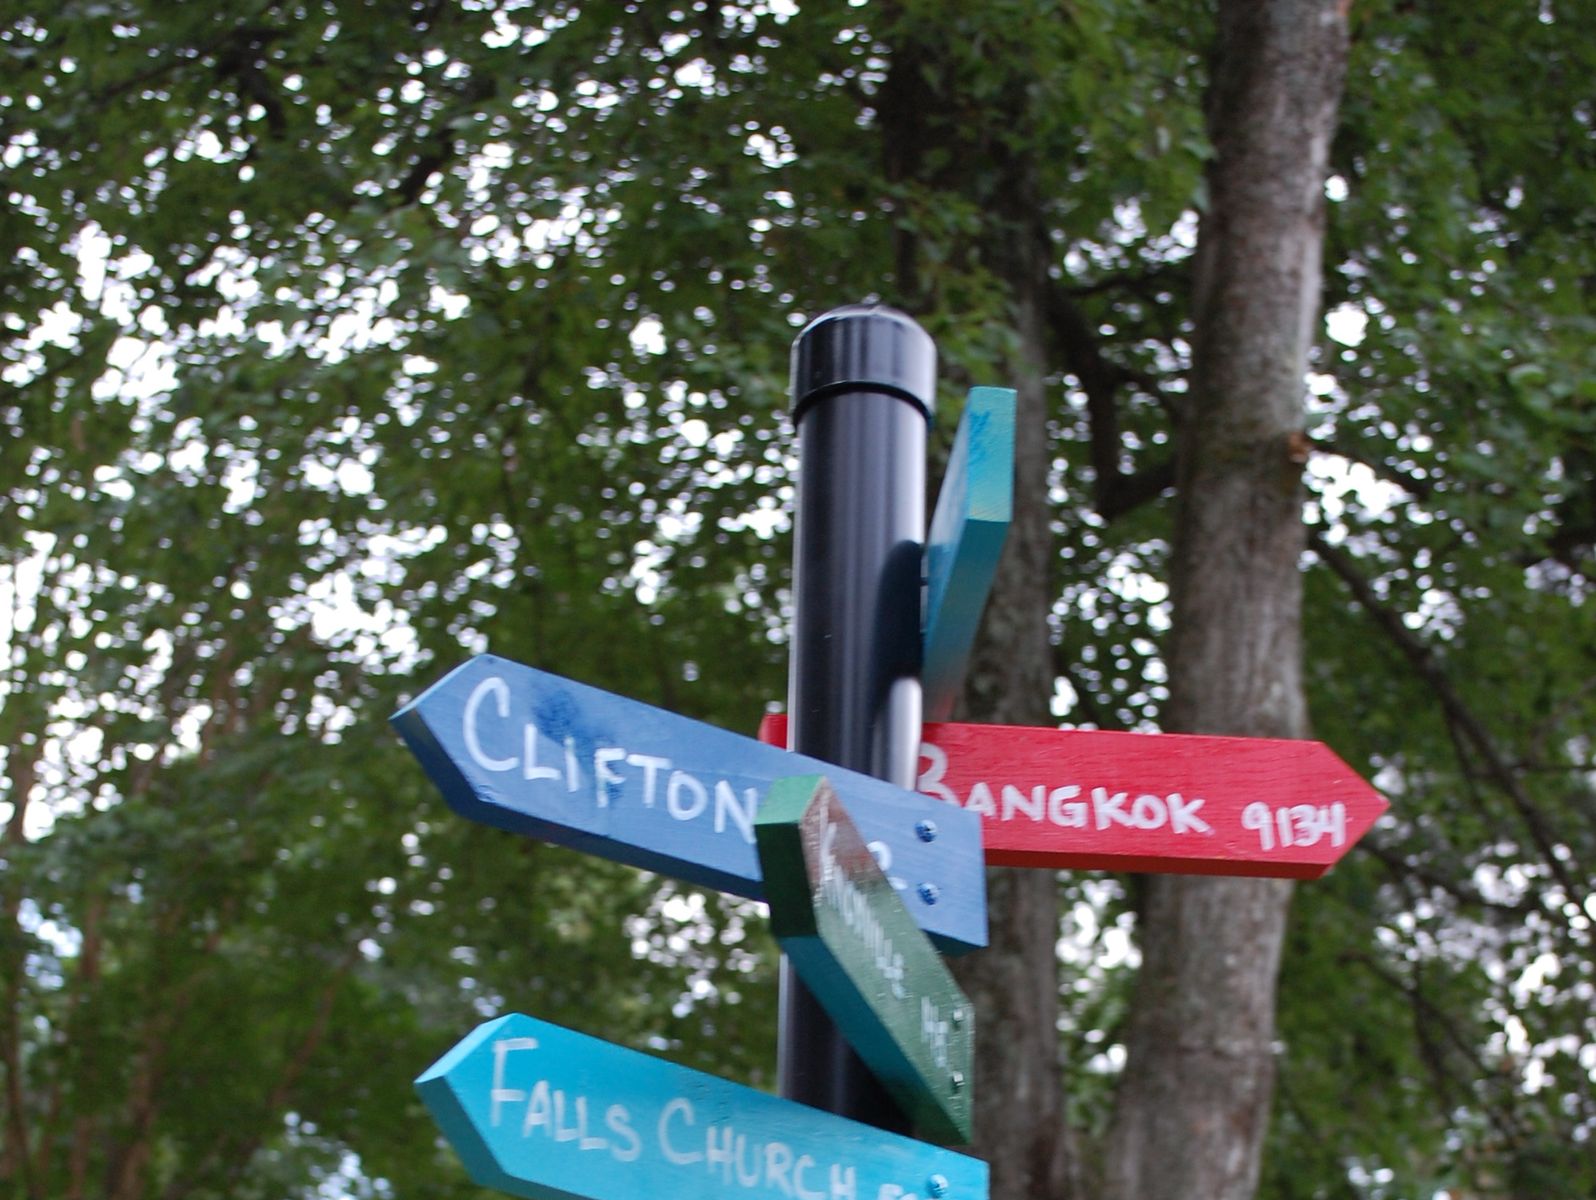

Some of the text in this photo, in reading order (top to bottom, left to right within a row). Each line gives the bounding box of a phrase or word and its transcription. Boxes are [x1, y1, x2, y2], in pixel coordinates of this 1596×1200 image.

[463, 677, 758, 844] CLIFTON
[916, 742, 1346, 852] BANGKOK 9134
[490, 1037, 642, 1162] FALLS
